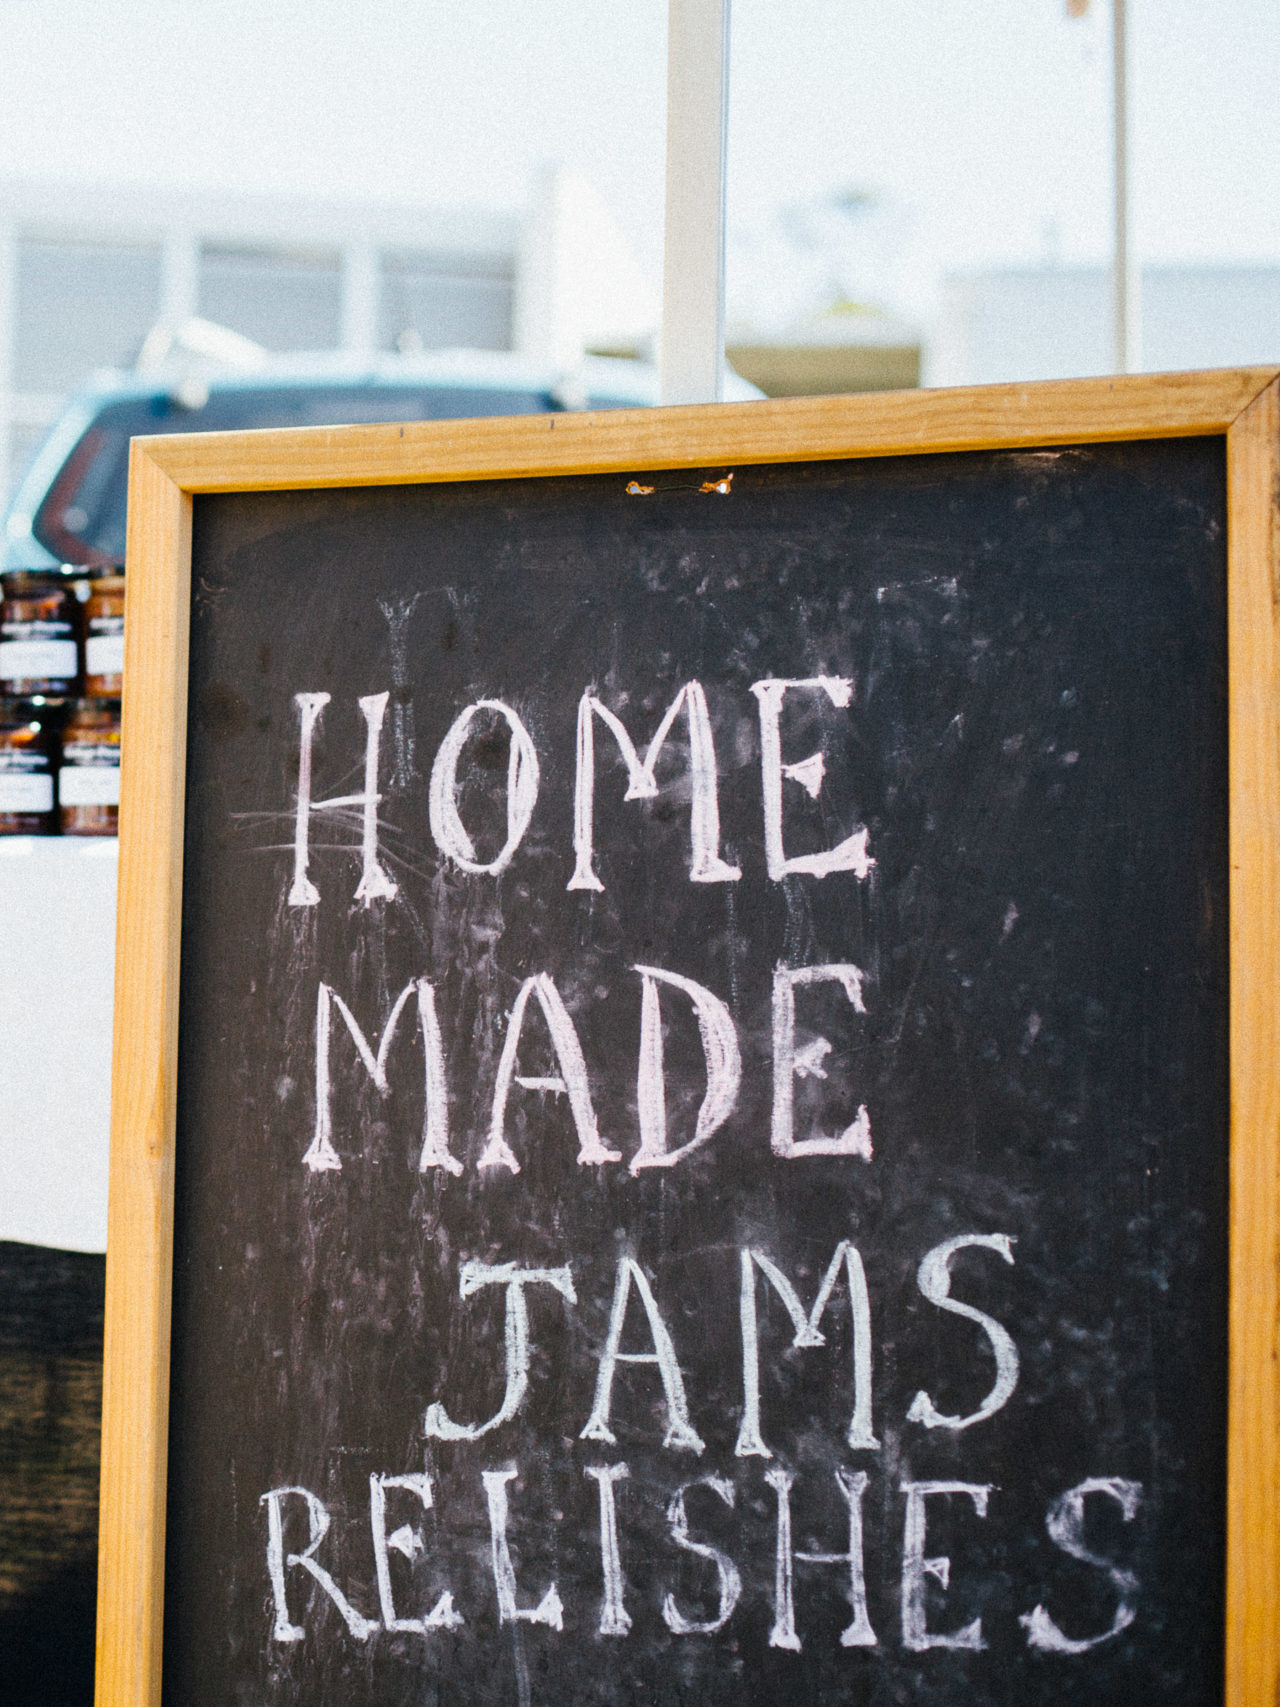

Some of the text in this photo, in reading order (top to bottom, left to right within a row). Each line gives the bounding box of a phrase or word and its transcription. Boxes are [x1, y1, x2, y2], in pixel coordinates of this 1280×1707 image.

[287, 677, 876, 906] HOME
[301, 960, 873, 1177] MADE
[424, 1232, 1020, 1458] JAMS
[259, 1461, 1143, 1654] RELISHES
